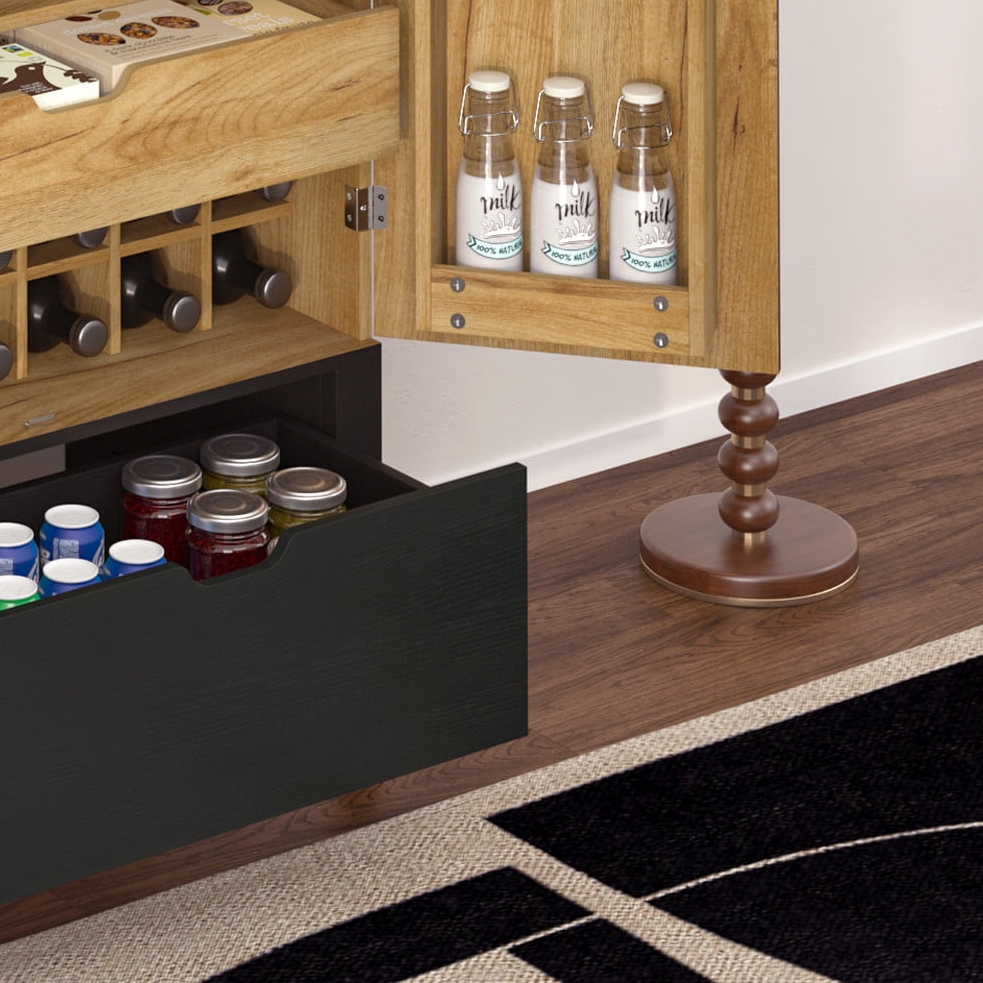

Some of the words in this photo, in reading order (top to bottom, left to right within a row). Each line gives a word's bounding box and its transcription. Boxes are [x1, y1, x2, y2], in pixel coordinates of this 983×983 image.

[481, 185, 522, 214] milk
[555, 191, 596, 221] milk
[635, 198, 675, 228] milk
[477, 244, 497, 255] 100%
[551, 251, 572, 261] 100%
[631, 258, 651, 268] 100%
